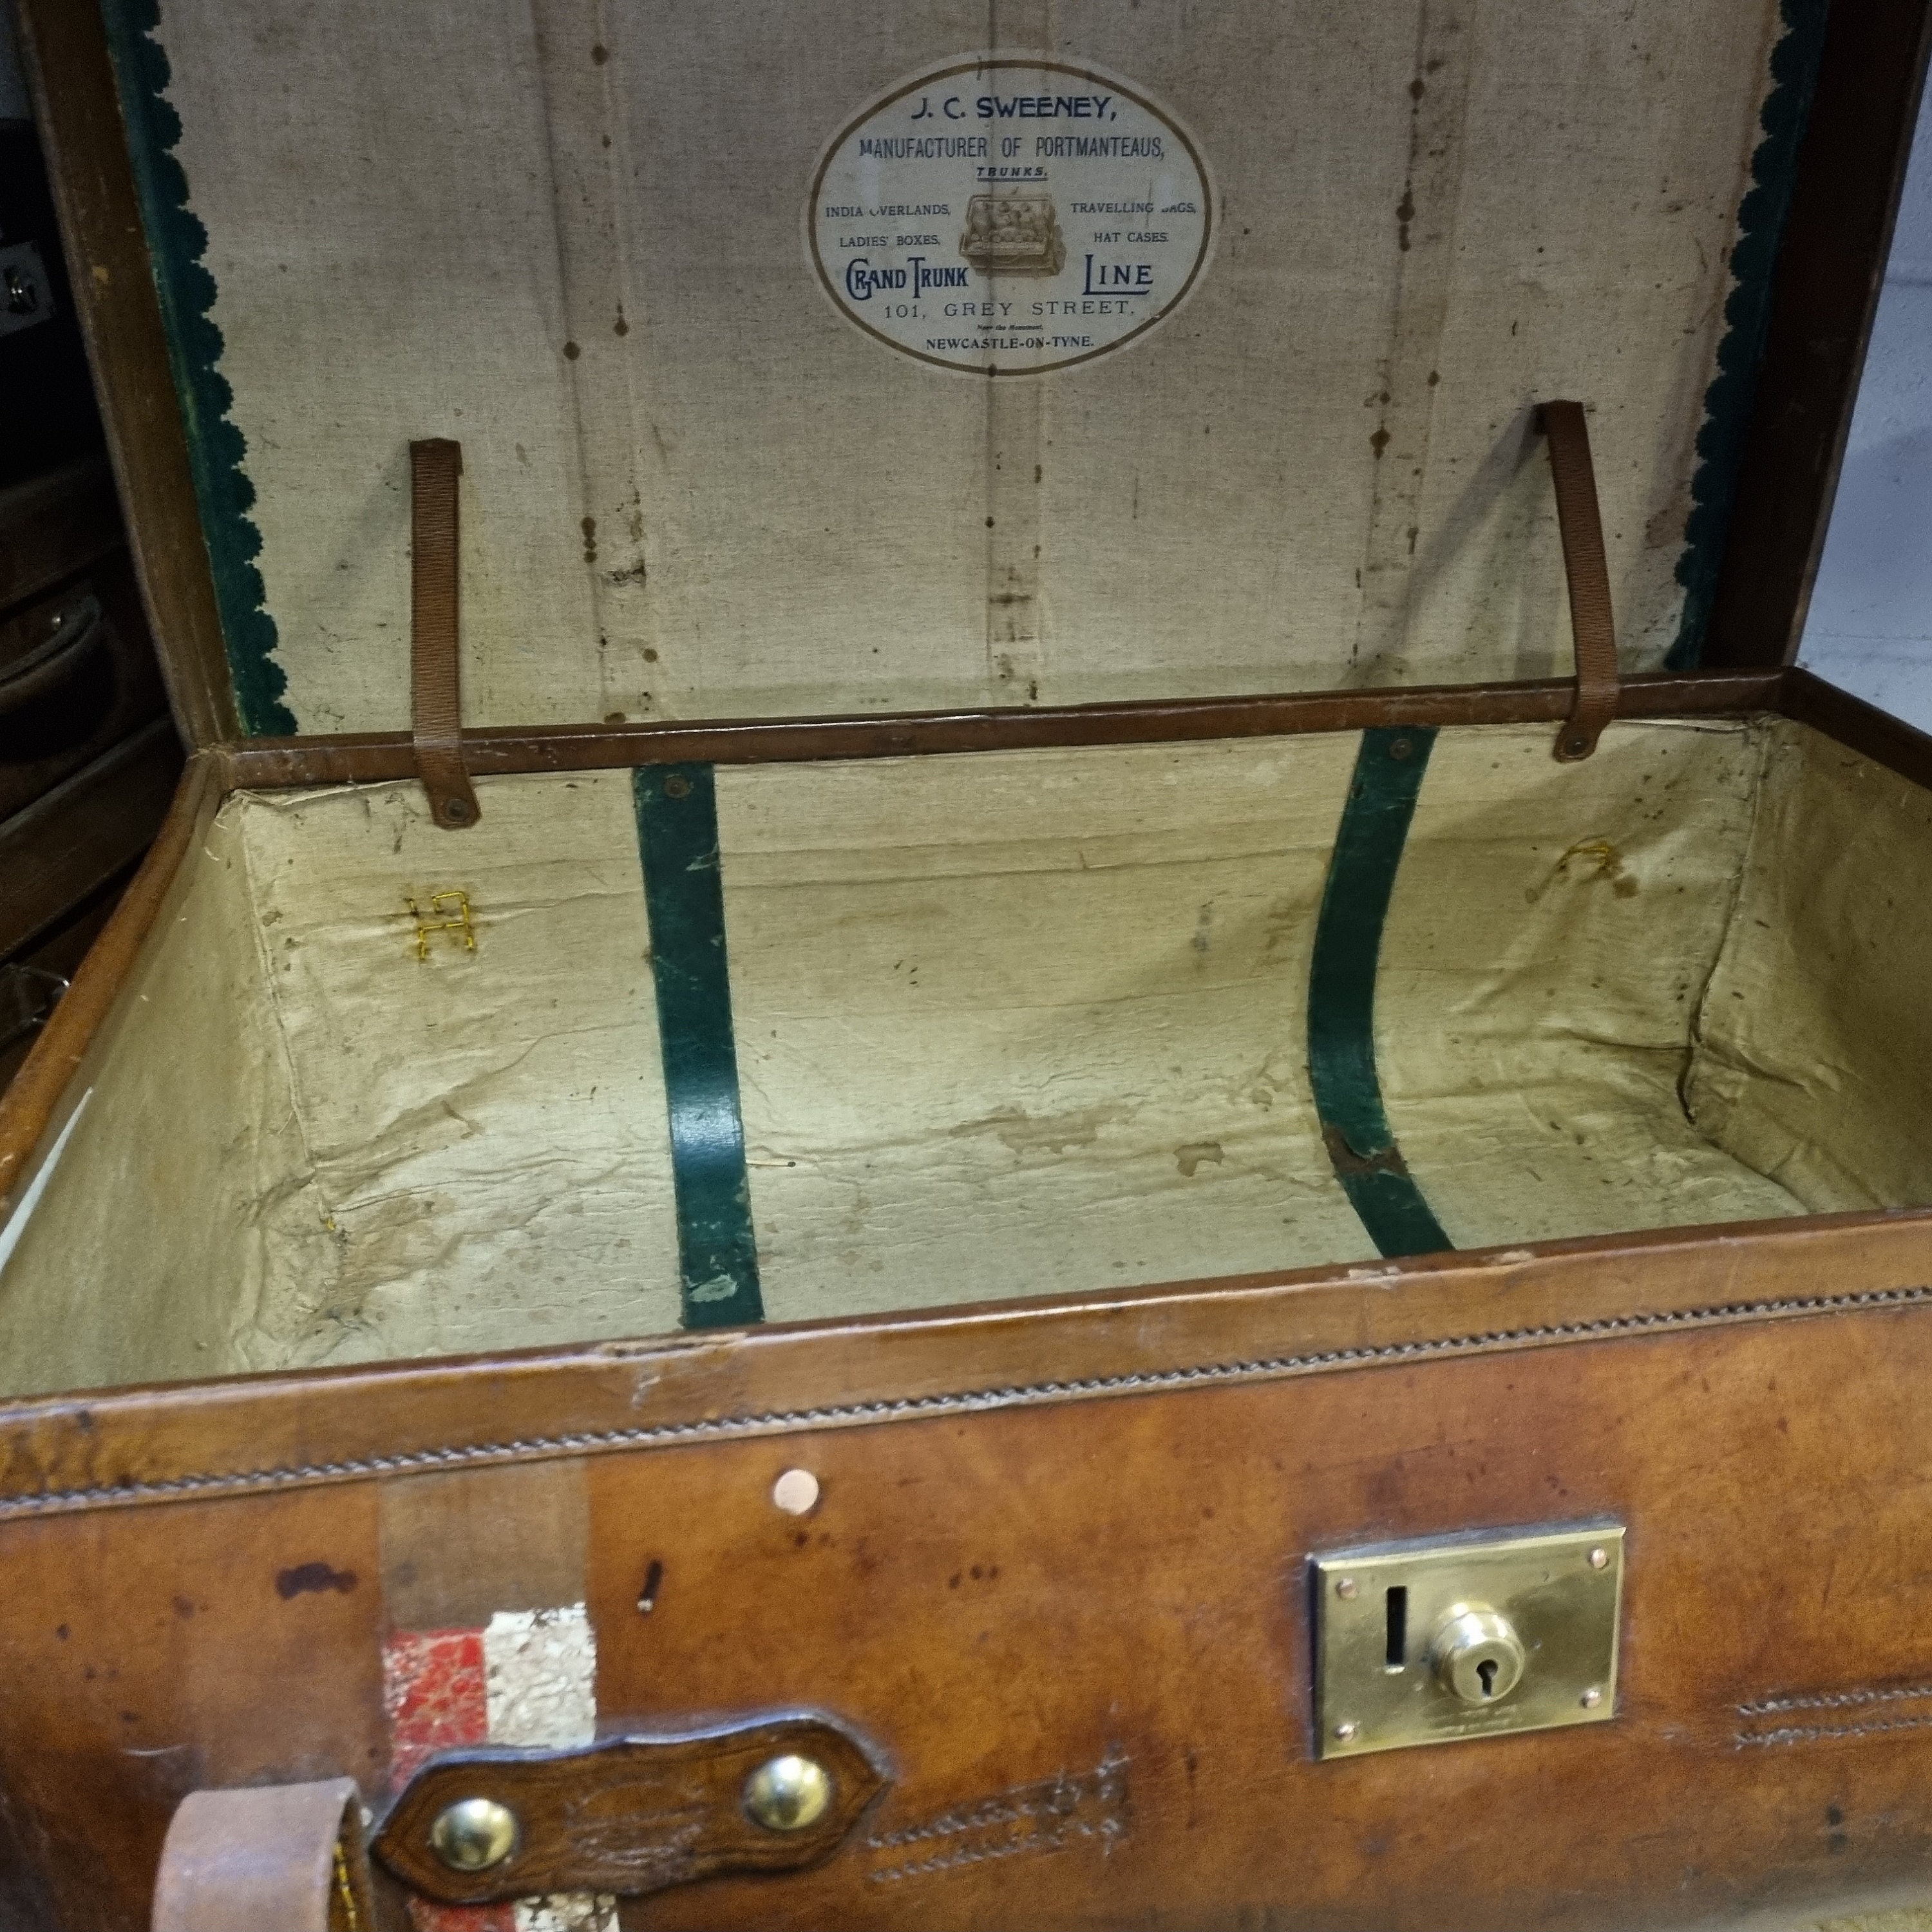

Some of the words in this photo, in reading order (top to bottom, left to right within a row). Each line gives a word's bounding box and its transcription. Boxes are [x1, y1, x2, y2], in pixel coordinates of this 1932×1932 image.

[911, 97, 933, 119] J.
[943, 97, 967, 120] C.
[976, 96, 1117, 121] SWEENEY,
[859, 137, 987, 158] MANUFACTURER
[1001, 137, 1022, 157] OF
[1036, 136, 1165, 160] PORTMANTEAUS,
[826, 206, 863, 218] INDIA
[1071, 202, 1154, 214] TRAVELLING
[1094, 232, 1121, 243] HAT
[846, 258, 906, 301] GRAND
[907, 256, 969, 299] TRUNK
[1082, 254, 1154, 296] LINE
[884, 304, 927, 319] 101,
[944, 301, 1013, 317] GREY
[926, 336, 1095, 351] NEWCASTLE-ON-TYNE.
